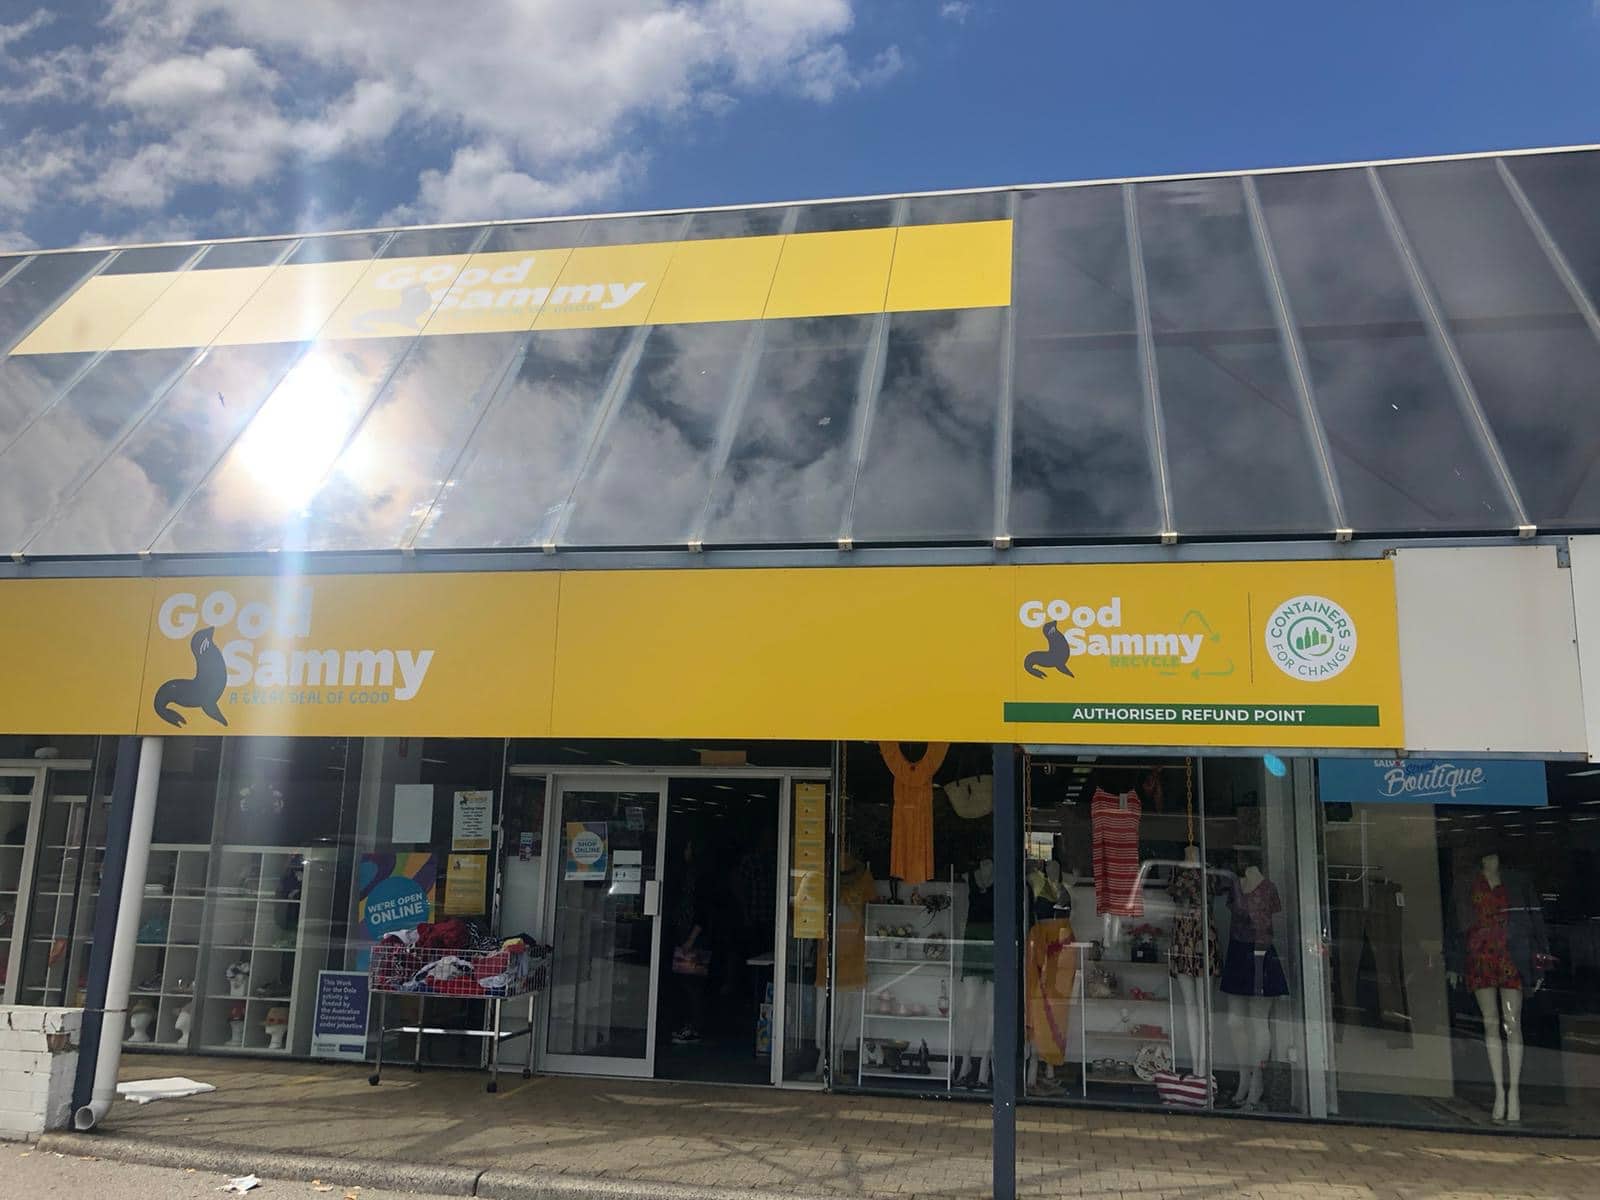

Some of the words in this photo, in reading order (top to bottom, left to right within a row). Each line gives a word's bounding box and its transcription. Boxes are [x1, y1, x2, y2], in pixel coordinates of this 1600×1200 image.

[374, 256, 535, 290] Good
[428, 281, 646, 310] Sammy
[158, 586, 313, 640] Good
[1019, 597, 1121, 628] Good
[1271, 601, 1351, 639] CONTAINERS
[1064, 628, 1204, 664] Sammy
[1110, 655, 1180, 668] RECYCLE
[1273, 643, 1295, 669] FOR
[1298, 643, 1350, 676] CHANGE
[224, 639, 435, 701] Sammy
[229, 691, 238, 704] A
[326, 691, 344, 704] OF
[349, 691, 390, 704] GOOD
[1072, 708, 1177, 721] AUTHORISED
[1182, 709, 1250, 722] REFUND
[1254, 710, 1306, 722] POINT
[1378, 763, 1485, 798] Boutique
[368, 900, 396, 913] WE'RE
[397, 893, 423, 905] OPEN
[370, 902, 424, 925] ONLINE
